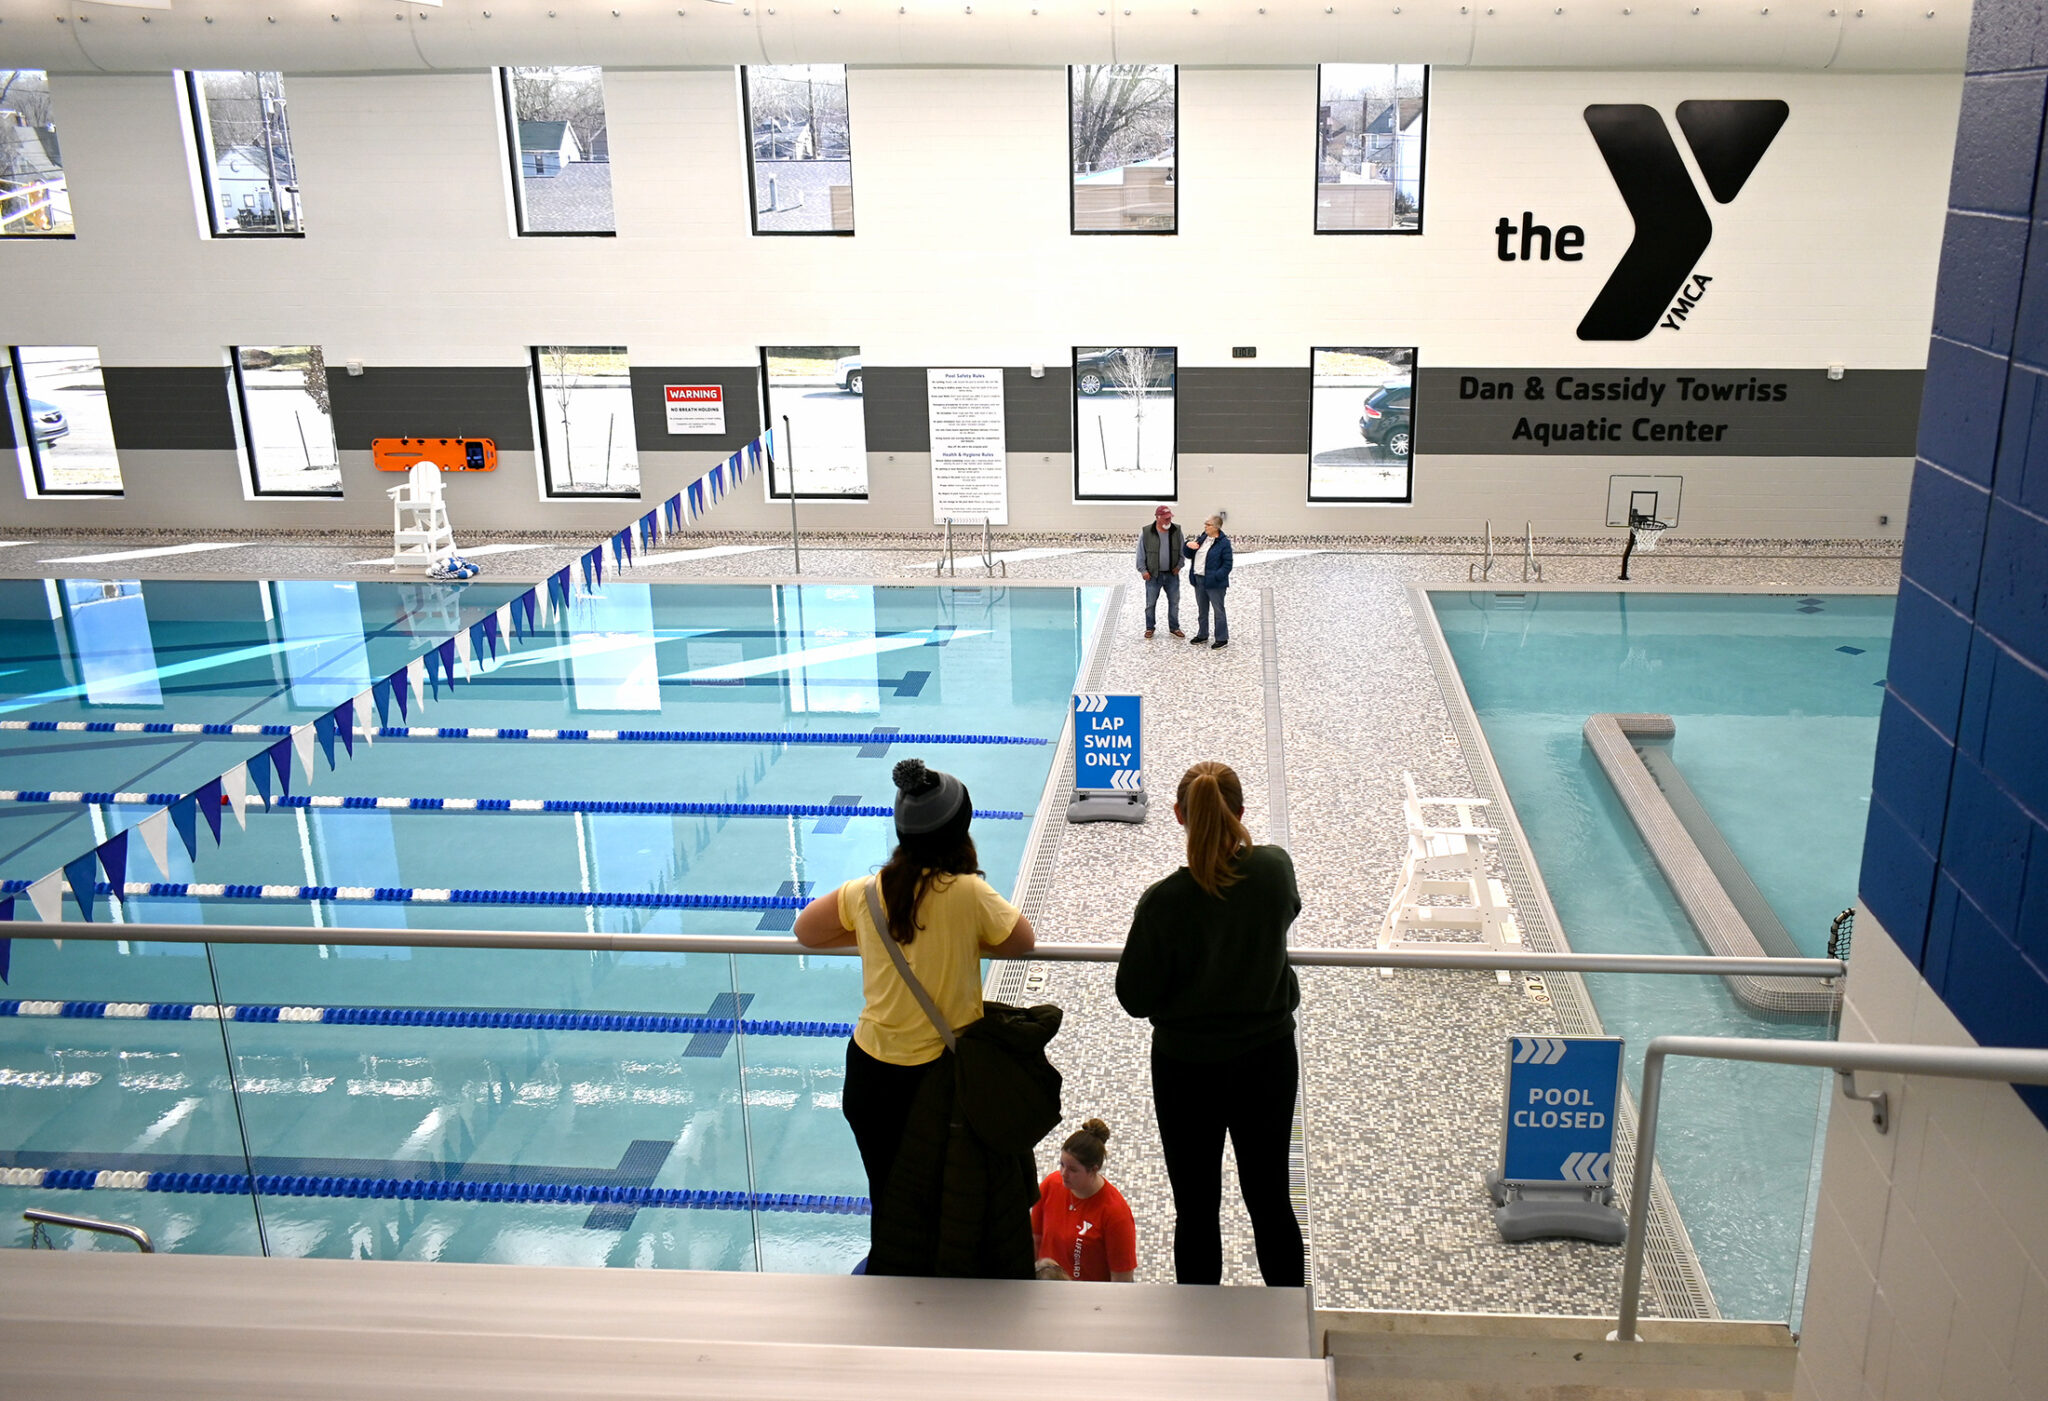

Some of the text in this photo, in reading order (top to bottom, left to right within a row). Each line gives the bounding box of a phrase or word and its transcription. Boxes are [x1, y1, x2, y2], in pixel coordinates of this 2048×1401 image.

[1495, 211, 1585, 262] the
[1660, 274, 1713, 331] YMCA
[670, 390, 718, 399] WARNING
[1459, 376, 1788, 407] Dan & Cassidy Towriss
[1512, 417, 1728, 447] Aquatic Center
[1092, 717, 1125, 731] LAP
[1084, 734, 1132, 749] SWIM
[1085, 752, 1132, 767] ONLY
[1528, 1088, 1594, 1106] POOL
[1513, 1110, 1605, 1129] CLOSED
